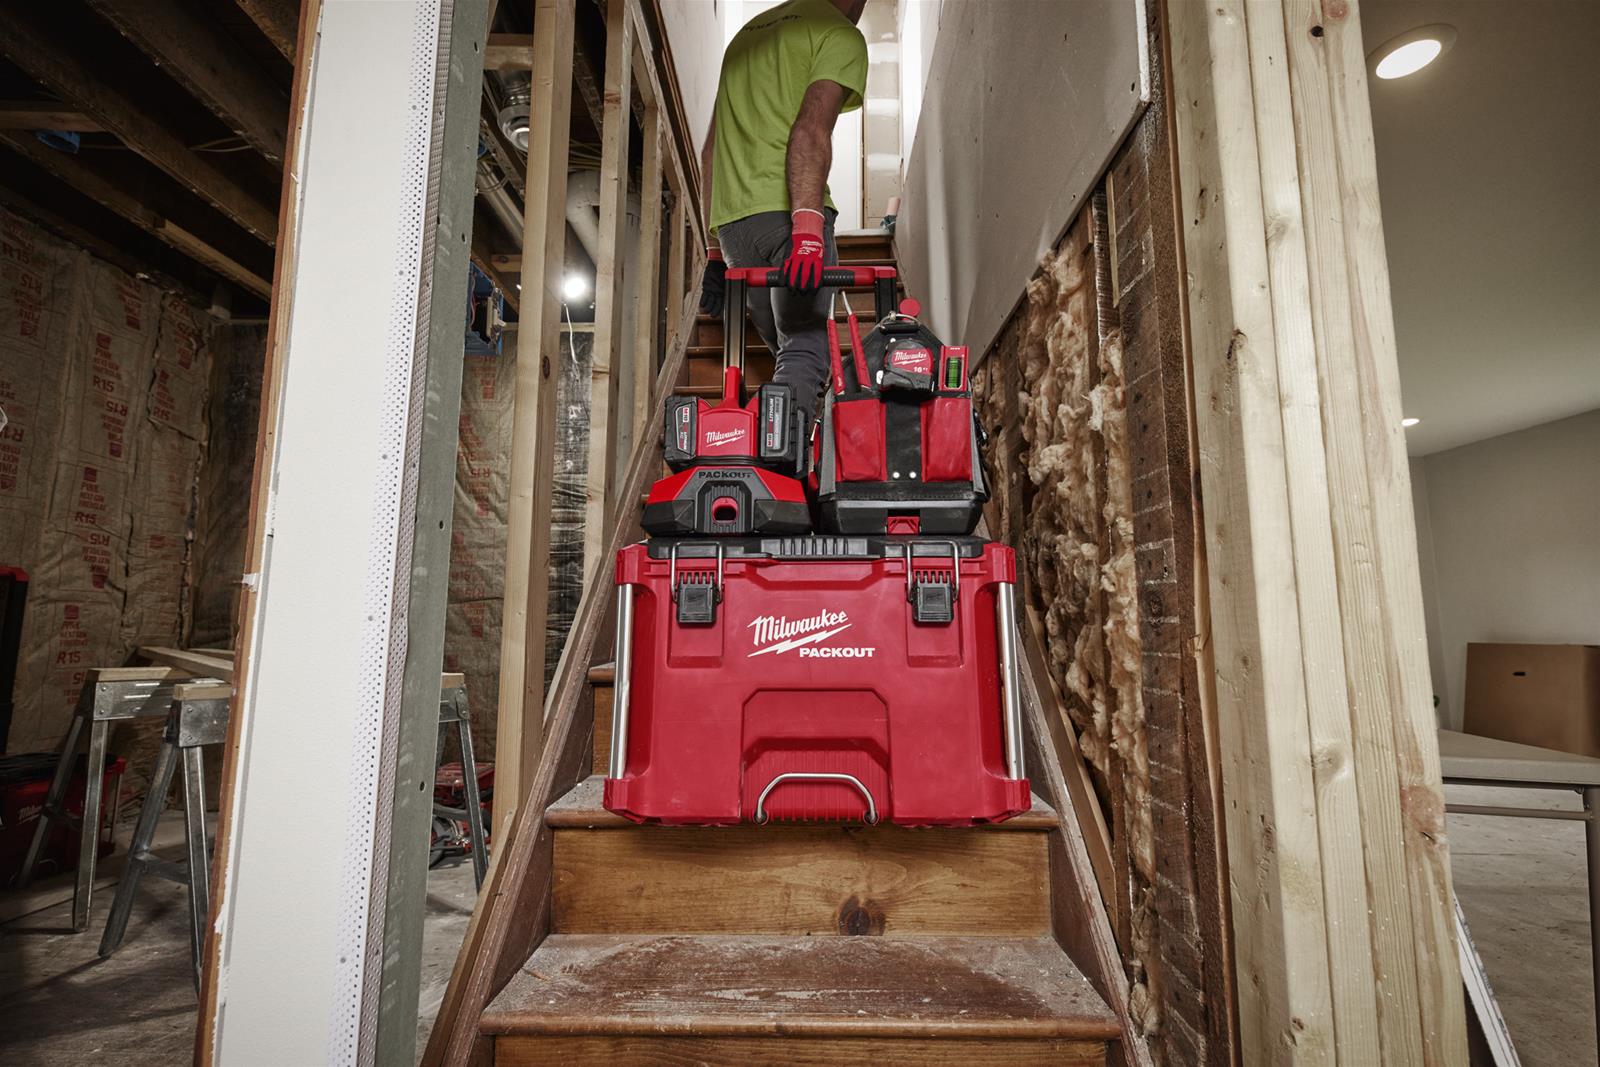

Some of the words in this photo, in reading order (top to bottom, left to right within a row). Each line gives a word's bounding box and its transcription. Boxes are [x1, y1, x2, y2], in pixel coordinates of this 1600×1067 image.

[894, 351, 927, 361] Milwaukee
[93, 375, 114, 392] R15
[106, 401, 128, 417] R15
[705, 428, 745, 443] Milwaukee
[698, 471, 752, 479] PACKOUT
[75, 511, 97, 524] R15
[90, 533, 110, 546] R15
[747, 608, 849, 646] Milwaukee
[56, 651, 81, 664] R15
[799, 647, 876, 658] PACKOUT
[17, 804, 43, 821] Milwa
